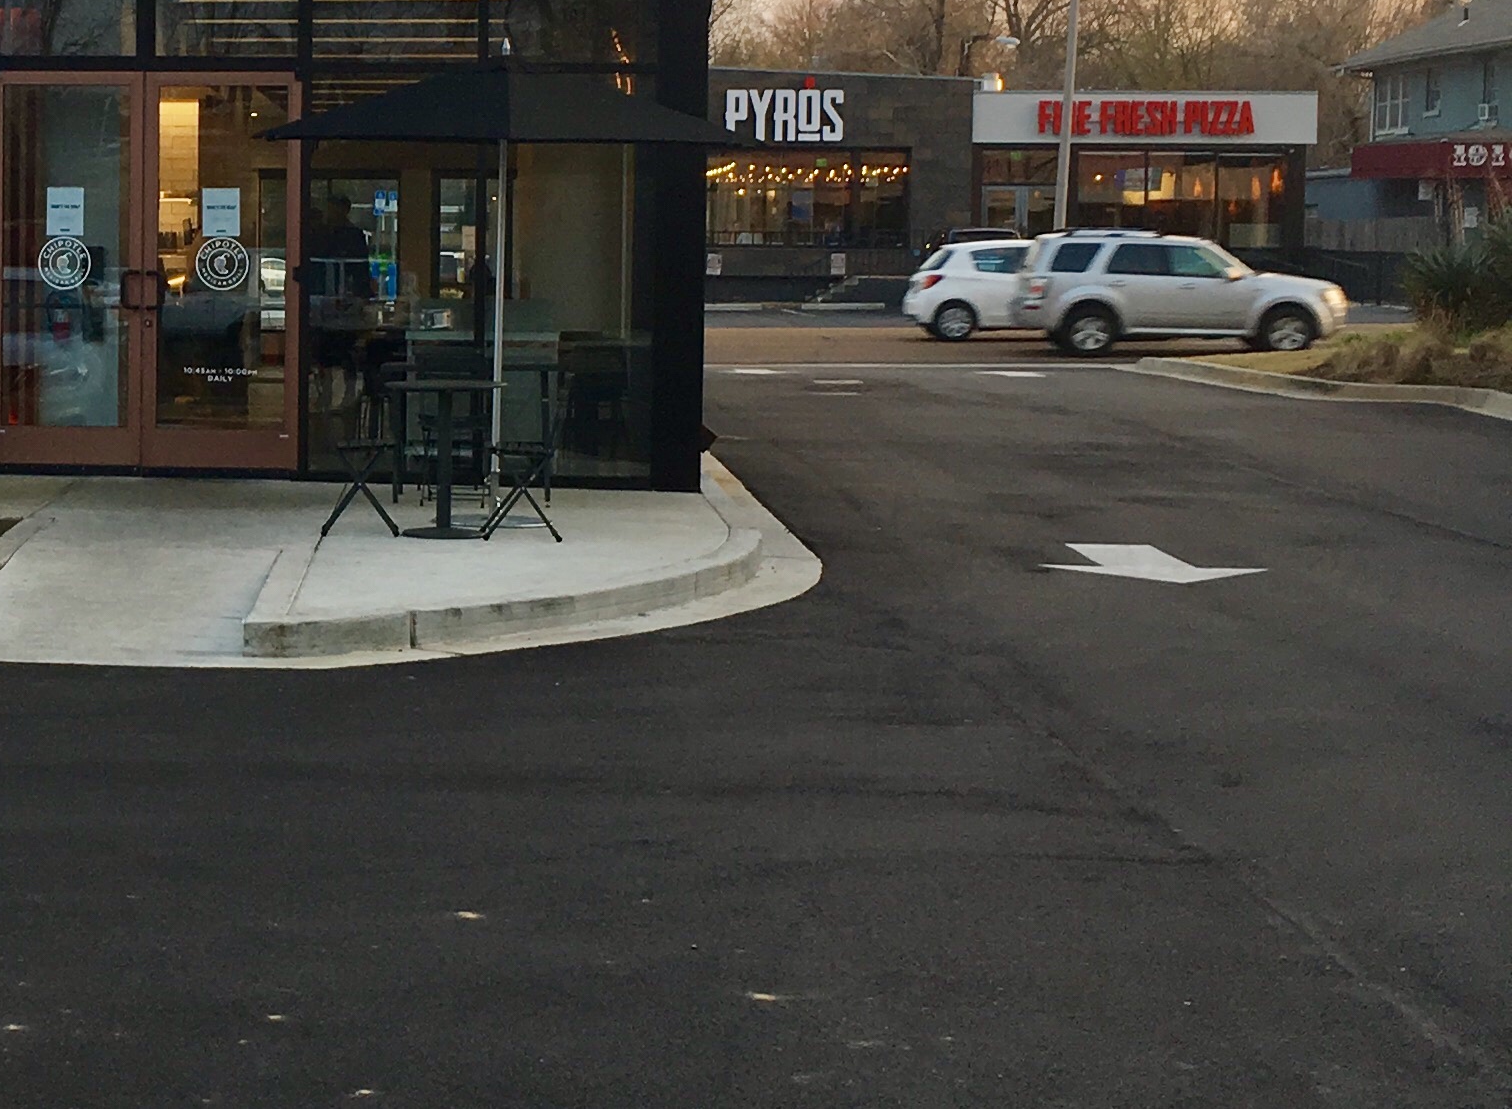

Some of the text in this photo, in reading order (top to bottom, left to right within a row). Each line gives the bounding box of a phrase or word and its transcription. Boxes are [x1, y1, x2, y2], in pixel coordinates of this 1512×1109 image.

[1038, 100, 1255, 136] FIE FRESH PIZZA
[43, 240, 87, 259] CHIPOTLE
[199, 240, 245, 260] CHIPOTLE
